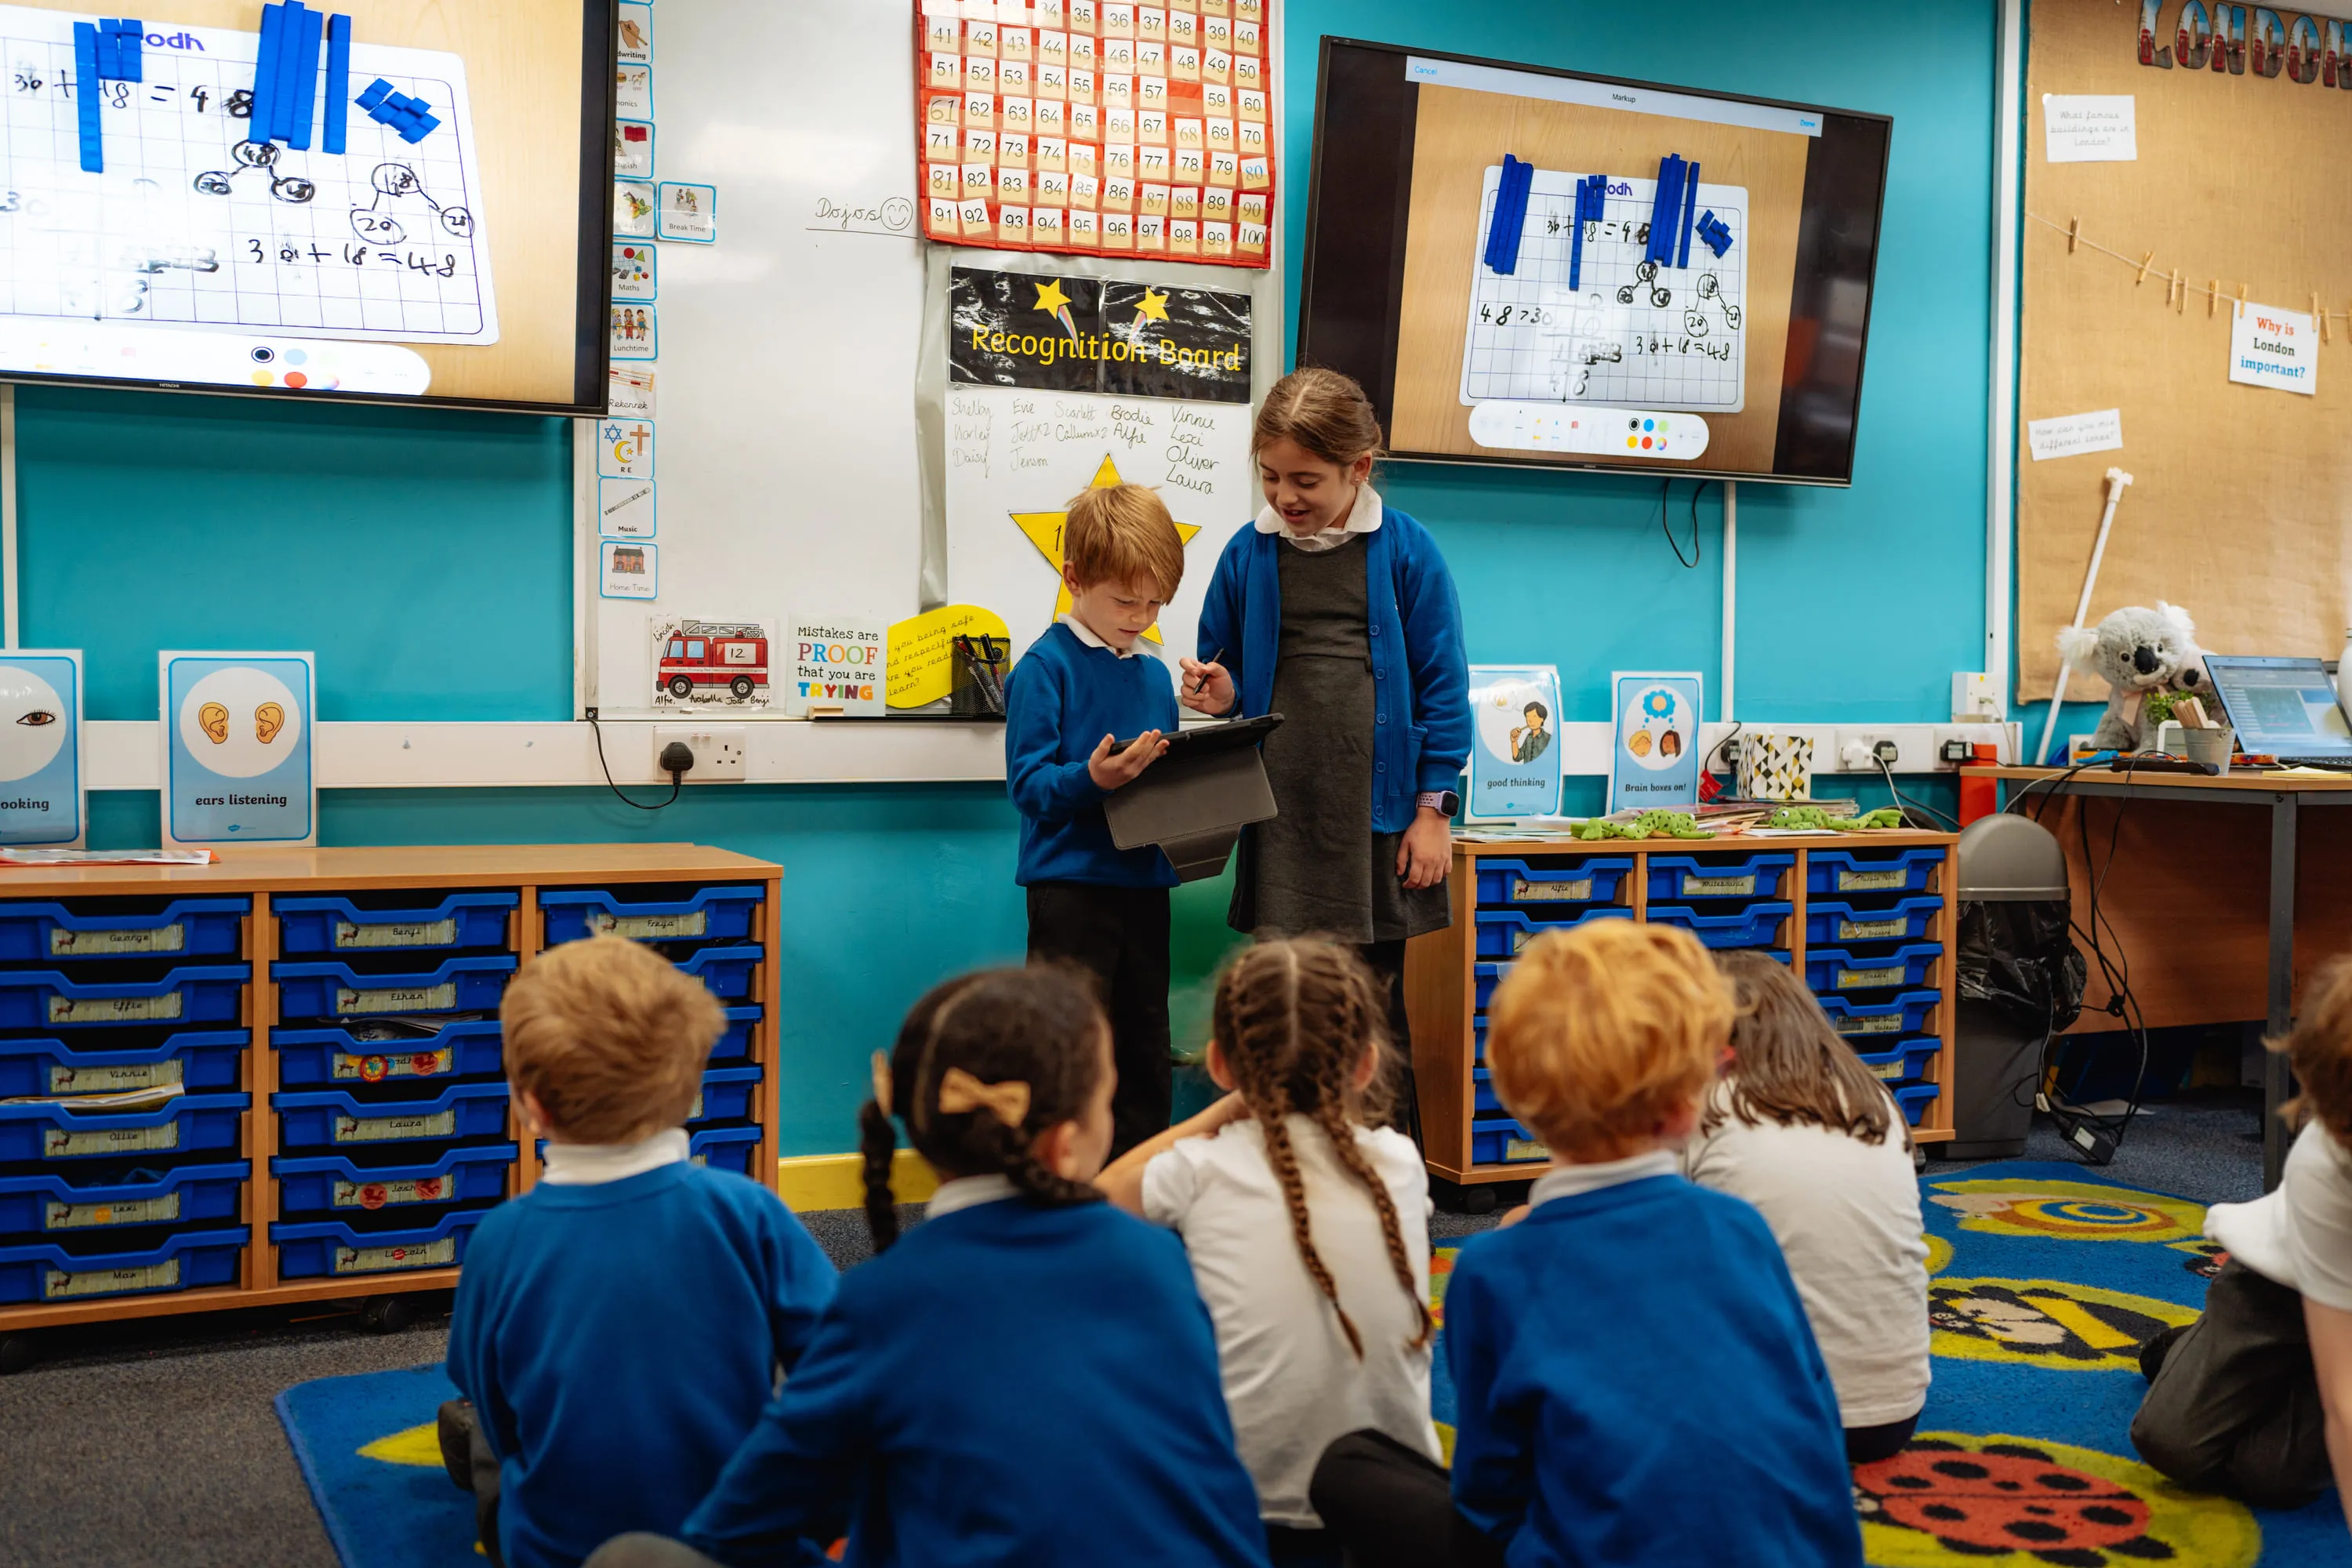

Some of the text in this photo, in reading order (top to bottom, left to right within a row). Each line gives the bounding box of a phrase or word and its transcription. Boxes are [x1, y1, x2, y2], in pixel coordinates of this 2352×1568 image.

[1043, 3, 1254, 45] 34 35 36 37 38 39 40
[934, 27, 1255, 79] 41 42 43 44 45 46 47 48 49 50
[2138, 0, 2352, 89] LONDON
[1414, 65, 1437, 76] Cancel
[936, 61, 1261, 112] 51 52 53 54 55 56 57 59 60
[1612, 93, 1636, 103] Markup
[930, 100, 1261, 145] 61 62 63 64 65 66 67 68 69 70
[1800, 119, 1816, 129] Done
[2060, 111, 2119, 122] What famous
[2050, 125, 2099, 134] buildings
[2074, 137, 2110, 146] London?
[931, 134, 1263, 181] 71 72 73 74 75 76 77 78 79 80
[933, 170, 1261, 217] 81 82 83 84 85 86 87 88 89 90
[815, 198, 880, 229] Dojos
[935, 207, 1265, 246] 91 92 93 94 95 96 97 98 99 100
[2257, 317, 2295, 336] Why is
[971, 323, 1240, 372] Recognition Board
[2253, 337, 2295, 356] London
[2241, 355, 2305, 378] important?
[608, 398, 648, 409] Rekenrek
[1013, 399, 1036, 414] Evie
[952, 397, 994, 431] Shelby
[1112, 405, 1154, 426] Brodie
[1172, 405, 1214, 430] Vinnie
[1114, 423, 1146, 449] Alfie
[1171, 425, 1203, 446] Lexi
[953, 448, 990, 478] Daisy
[1167, 446, 1219, 470] Oliver
[1167, 464, 1214, 495] Laura
[610, 583, 630, 591] Home
[797, 626, 878, 641] Mistakes are
[895, 615, 974, 652] you being safe
[731, 648, 745, 658] 12
[797, 642, 878, 665] PROOF
[797, 665, 875, 681] that you are
[905, 666, 923, 677] you
[798, 682, 873, 701] TRYING
[888, 677, 920, 696] learn?
[1486, 778, 1545, 789] good thinking
[1624, 783, 1648, 792] Brain
[1, 797, 49, 813] ooking
[195, 794, 287, 807] ears listening
[393, 928, 421, 937] Benji
[648, 919, 674, 928] Freya
[110, 935, 149, 943] George
[114, 1001, 142, 1011] Effie
[392, 1184, 416, 1192] Josh
